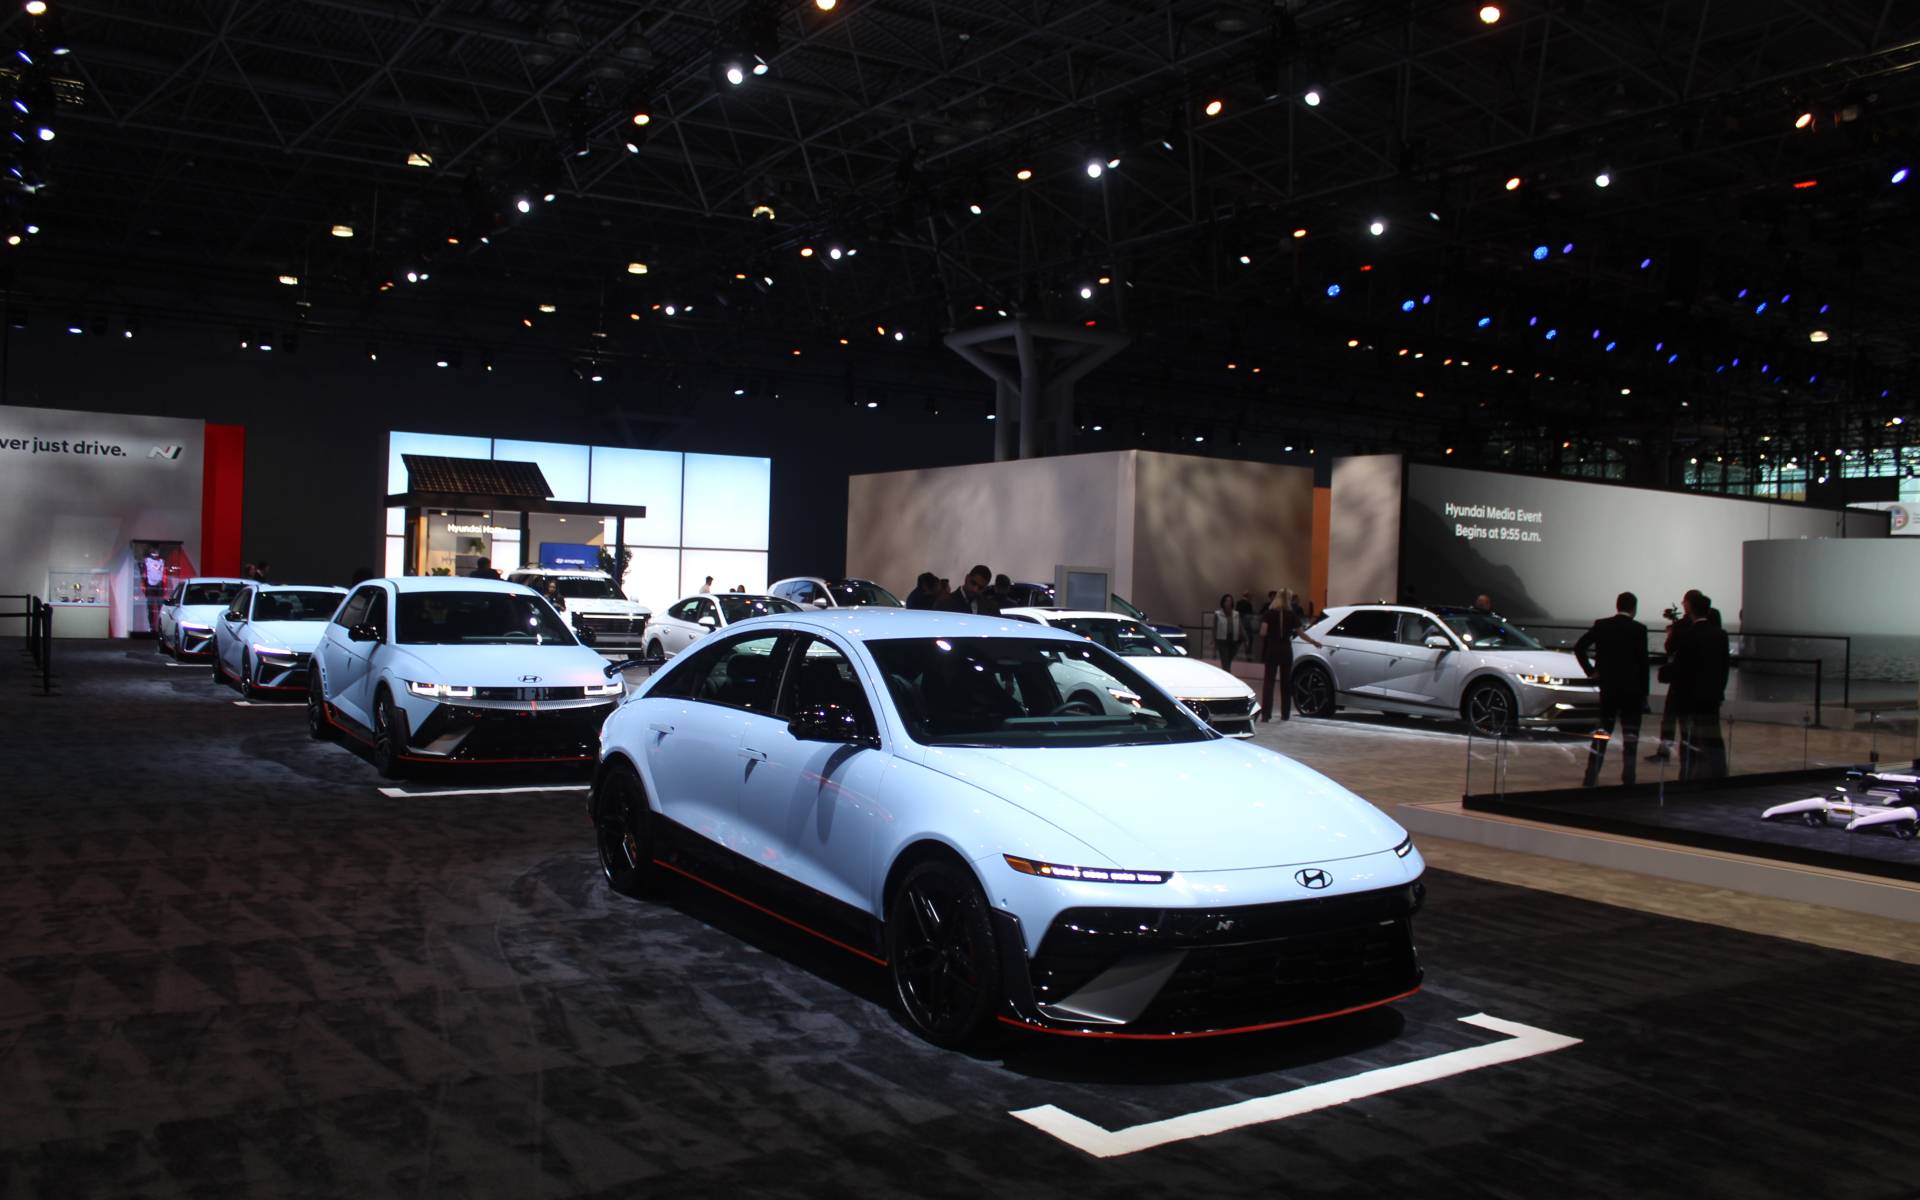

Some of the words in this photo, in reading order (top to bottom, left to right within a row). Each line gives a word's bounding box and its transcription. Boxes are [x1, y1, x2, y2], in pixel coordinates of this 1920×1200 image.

[33, 437, 69, 453] just
[73, 440, 126, 456] drive.
[1445, 503, 1485, 518] Hyundai
[1486, 507, 1515, 520] Media
[1517, 509, 1542, 523] Event
[447, 523, 482, 533] Hyundai
[1455, 523, 1487, 539] Begins
[1488, 528, 1499, 539] at
[1500, 527, 1520, 540] 9:55
[1521, 531, 1542, 542] a.m.
